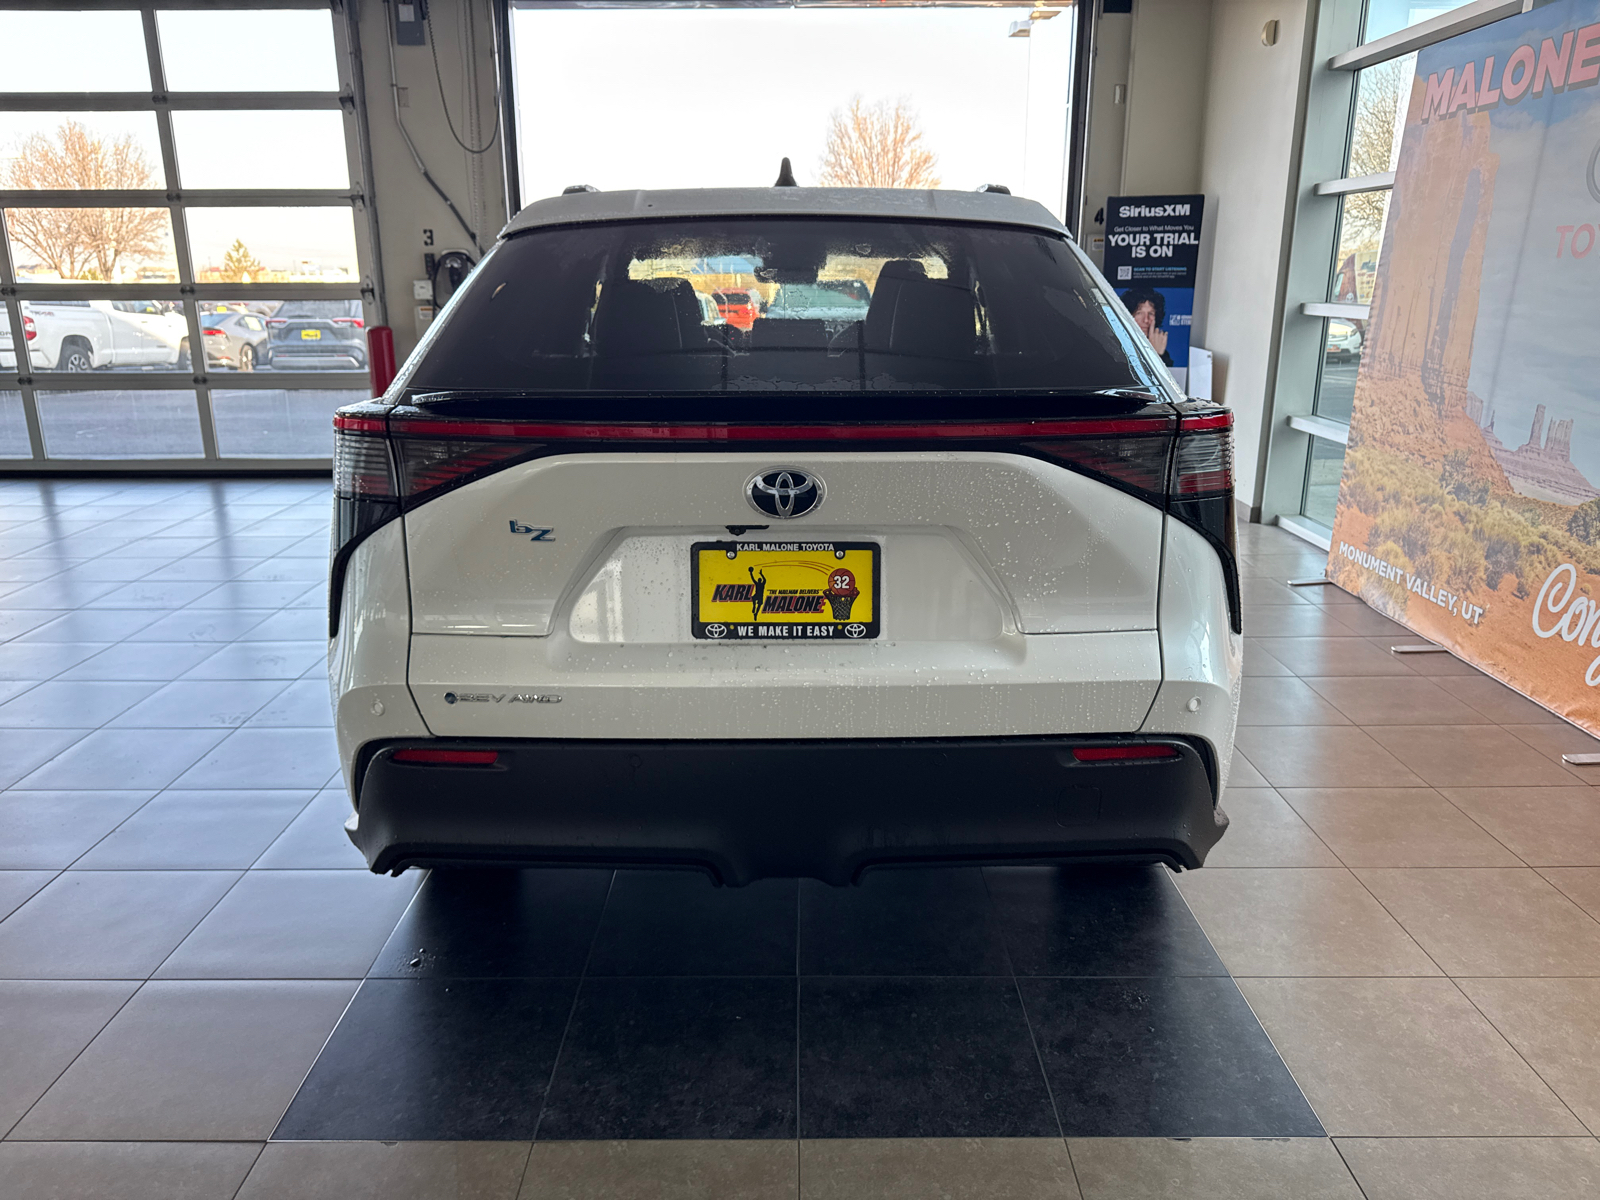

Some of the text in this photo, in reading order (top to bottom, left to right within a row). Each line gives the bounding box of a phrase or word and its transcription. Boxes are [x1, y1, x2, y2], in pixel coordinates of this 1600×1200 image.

[1421, 23, 1600, 123] MALONE
[1094, 207, 1104, 226] 4
[1119, 204, 1191, 218] SiriusXM
[423, 229, 434, 246] 3
[1108, 232, 1199, 247] YOUR TRIAL
[1556, 223, 1600, 259] TO
[1131, 245, 1173, 258] IS ON
[736, 543, 835, 551] KARL MALONE TOYOTA
[833, 575, 850, 589] 32
[1339, 541, 1484, 624] MONUMENT VALLEY, UT
[711, 584, 755, 603] KARL
[761, 595, 827, 614] MALONE
[737, 625, 834, 637] WE MAKE IT EASY
[507, 693, 563, 704] AWD
